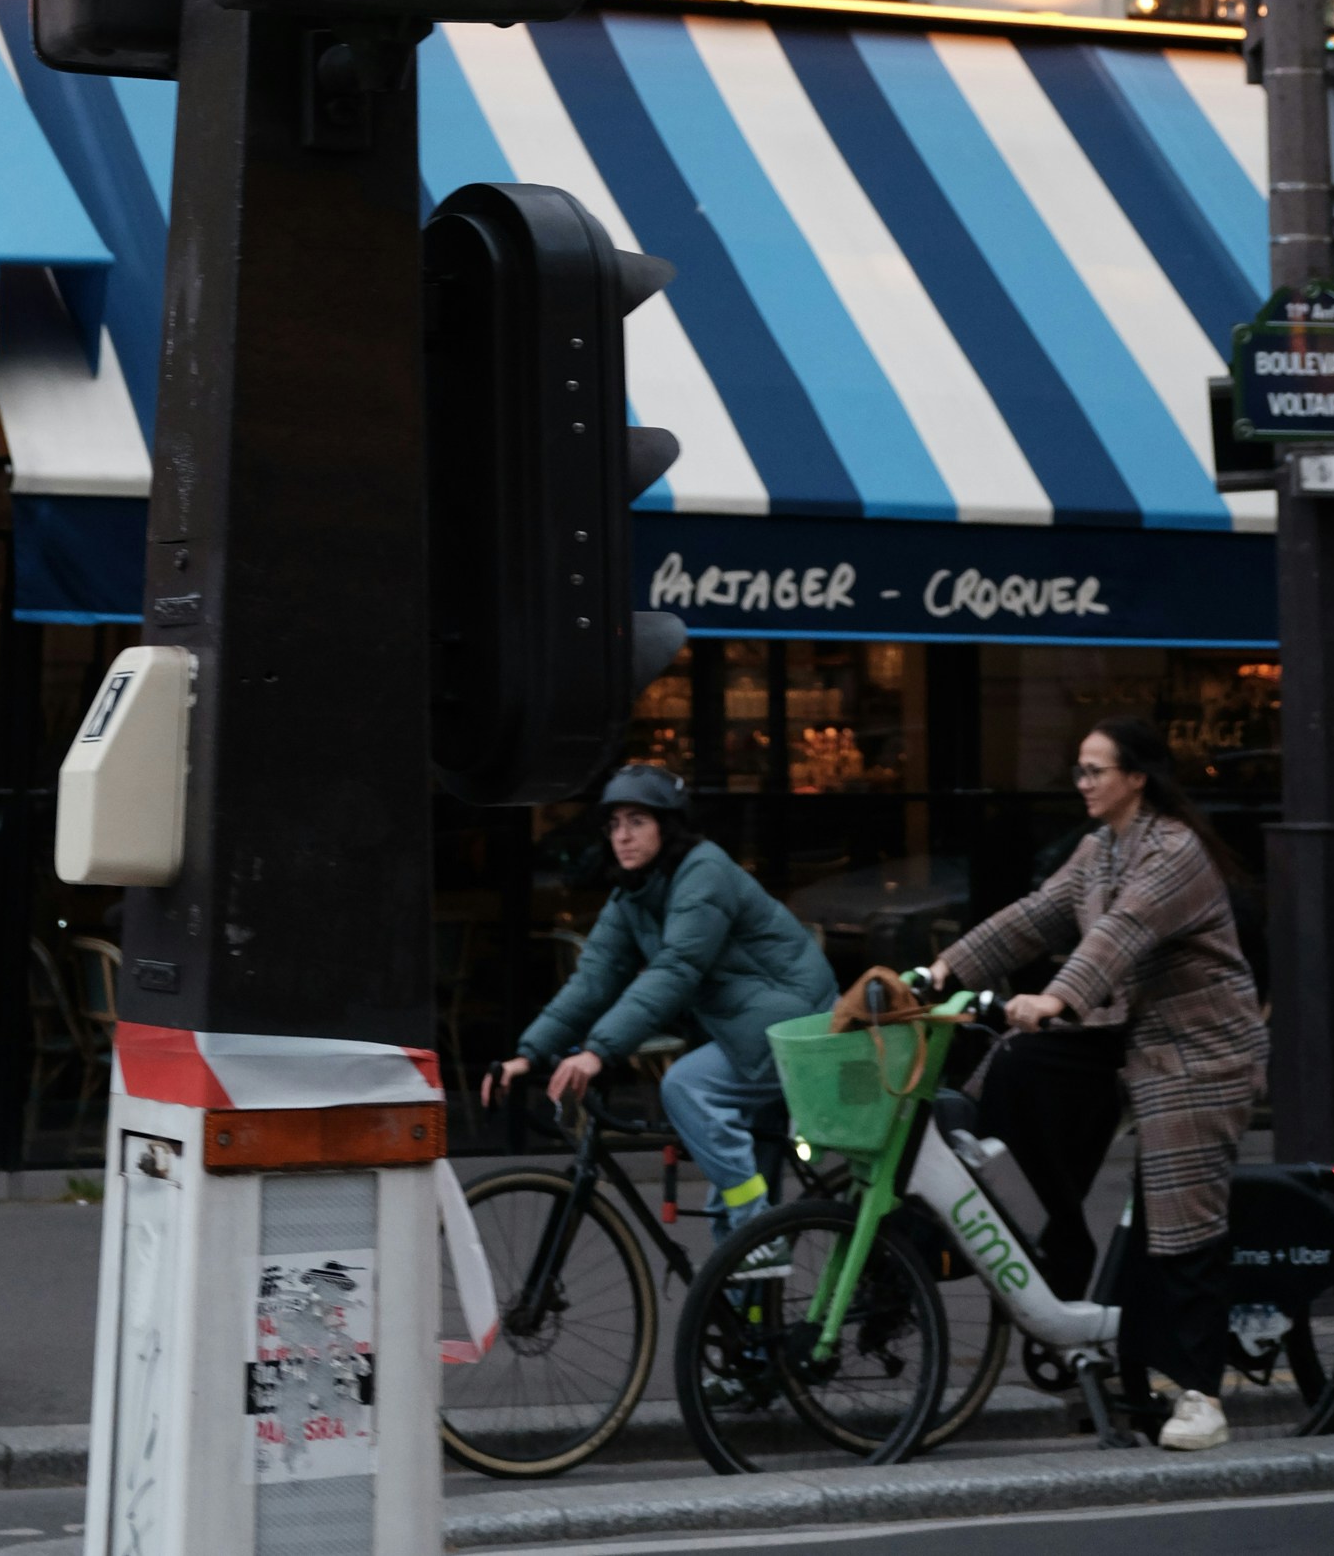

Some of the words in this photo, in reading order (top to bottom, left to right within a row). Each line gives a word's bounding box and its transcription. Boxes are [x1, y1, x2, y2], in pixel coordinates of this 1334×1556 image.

[649, 551, 857, 611] PARTAGER
[923, 567, 1110, 620] CROQUER
[951, 1187, 1030, 1294] Lime
[1289, 1245, 1331, 1266] Uber
